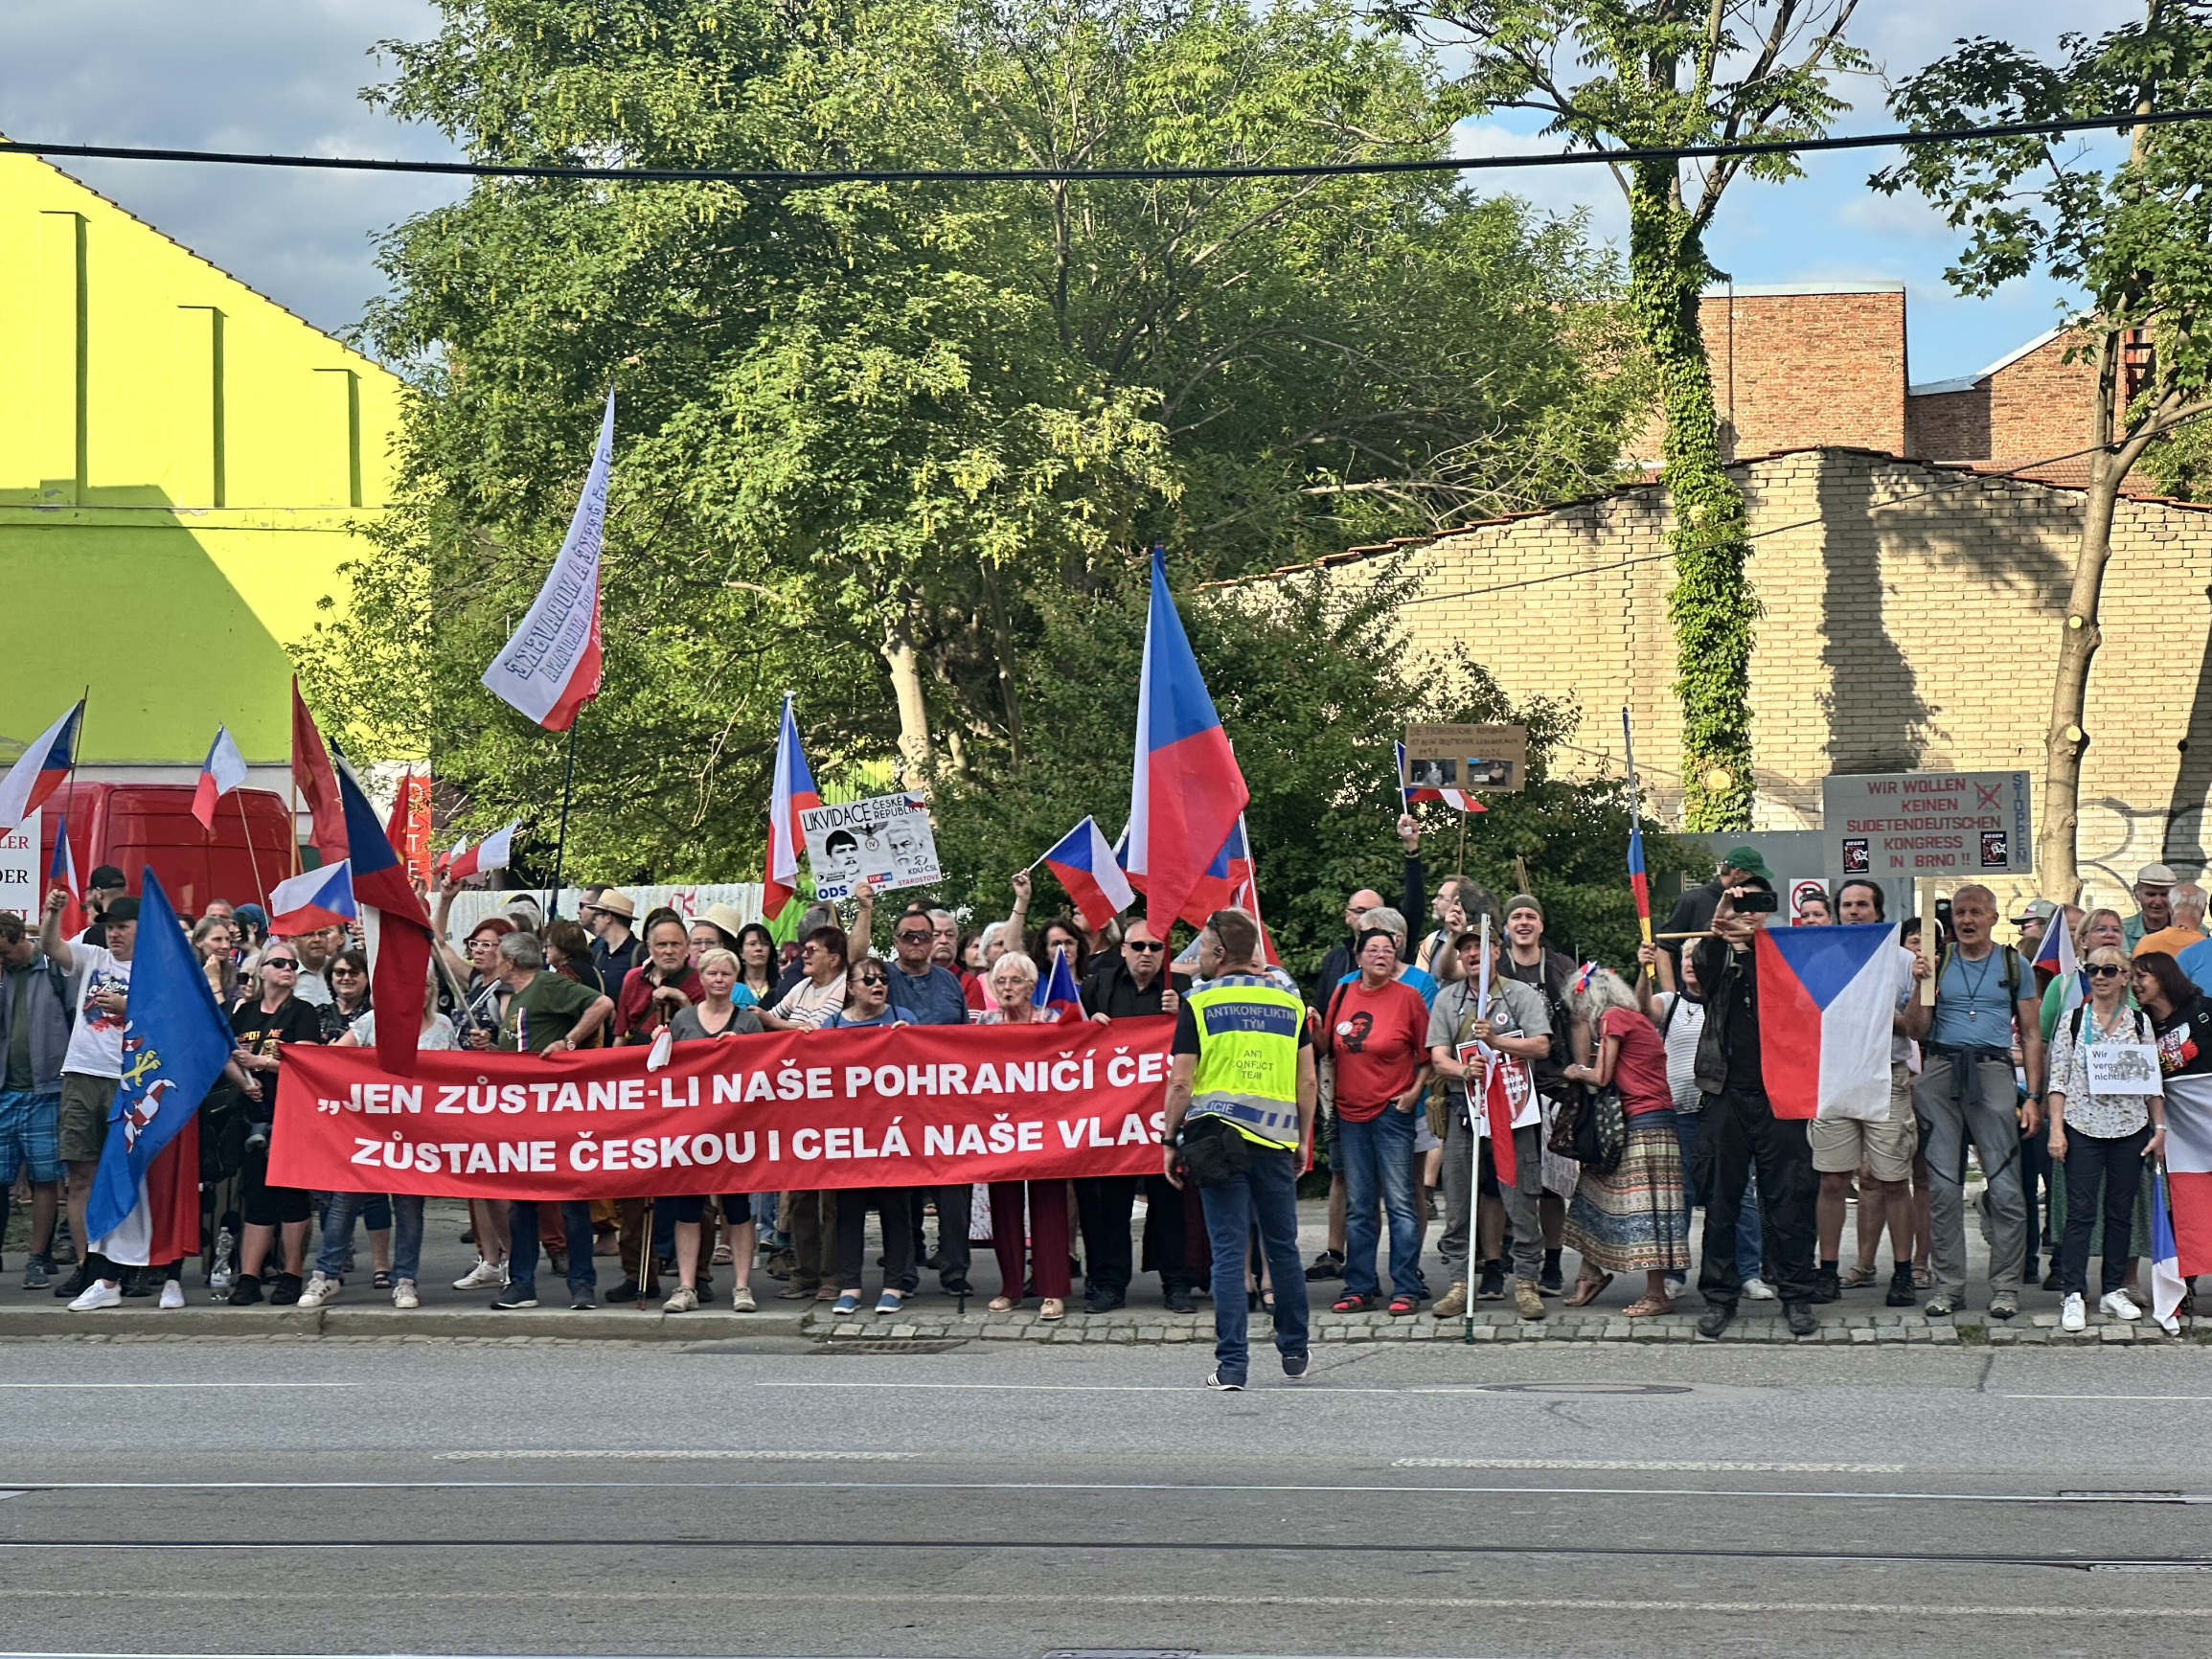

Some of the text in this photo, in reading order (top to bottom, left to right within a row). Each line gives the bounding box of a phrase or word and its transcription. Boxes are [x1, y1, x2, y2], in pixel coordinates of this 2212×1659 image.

[1867, 778, 1966, 794] WIR WOLLEN
[872, 795, 902, 809] ČESKÉ
[1902, 798, 1958, 812] KEINEN
[802, 803, 872, 831] LIKVIDACE
[1847, 815, 2001, 832] SUDETENDEUTSCHEN
[2013, 774, 2028, 864] STOPPEN
[1883, 835, 1963, 851] KONGRESS
[1889, 855, 1904, 868] IN
[1914, 853, 1956, 867] BRNO
[898, 873, 939, 886] STAROSTOVÉ
[818, 885, 848, 899] ODS
[1242, 1016, 1265, 1030] TÝM
[435, 1076, 699, 1115] ZŮSTANE-LI
[712, 1058, 833, 1105] NAŠE
[845, 1049, 1097, 1099] POHRANIČÍ
[351, 1130, 557, 1174] ZŮSTANE
[569, 1130, 756, 1173] ČESKOU
[767, 1130, 781, 1162] I
[791, 1115, 911, 1161] CELÁ
[924, 1112, 1044, 1157] NAŠE
